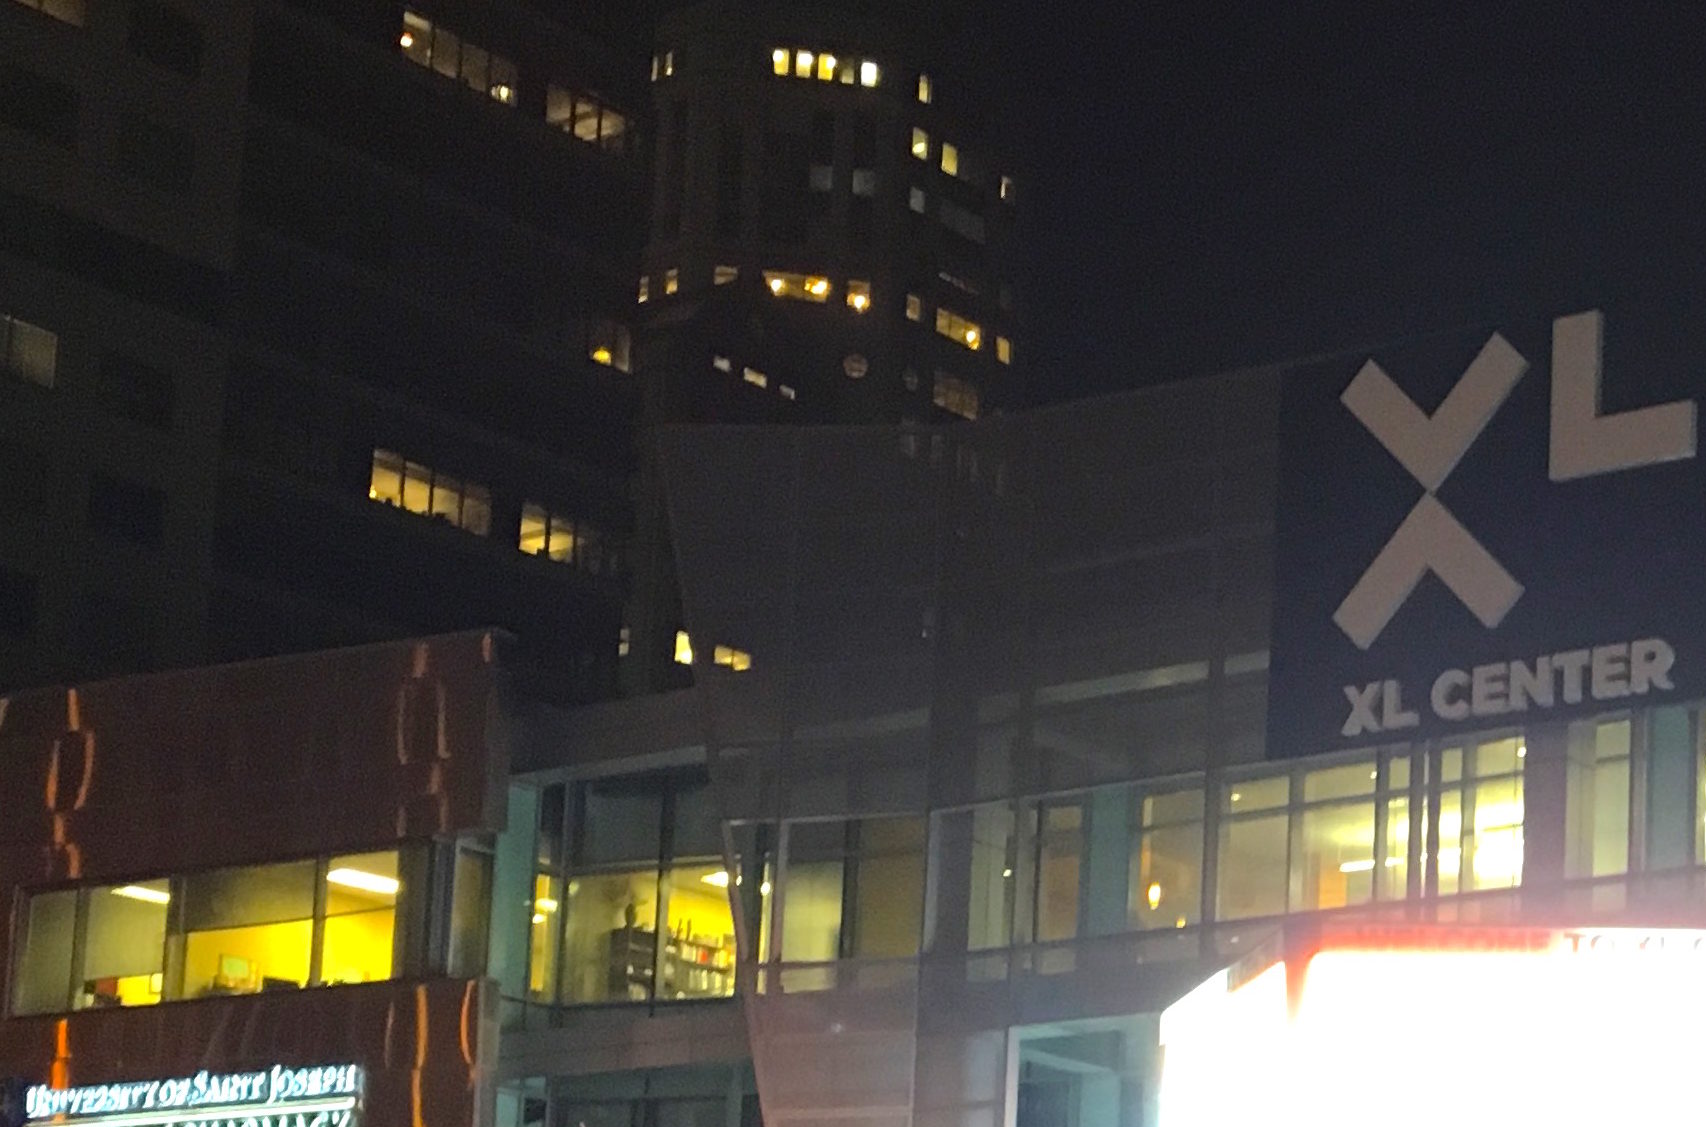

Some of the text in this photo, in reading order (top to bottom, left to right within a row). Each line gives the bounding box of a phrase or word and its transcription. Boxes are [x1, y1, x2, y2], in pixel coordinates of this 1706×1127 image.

[1332, 309, 1698, 650] XL
[1341, 638, 1676, 736] XL CENTER
[189, 1069, 267, 1106] SAINT
[267, 1064, 356, 1105] JOSEPH
